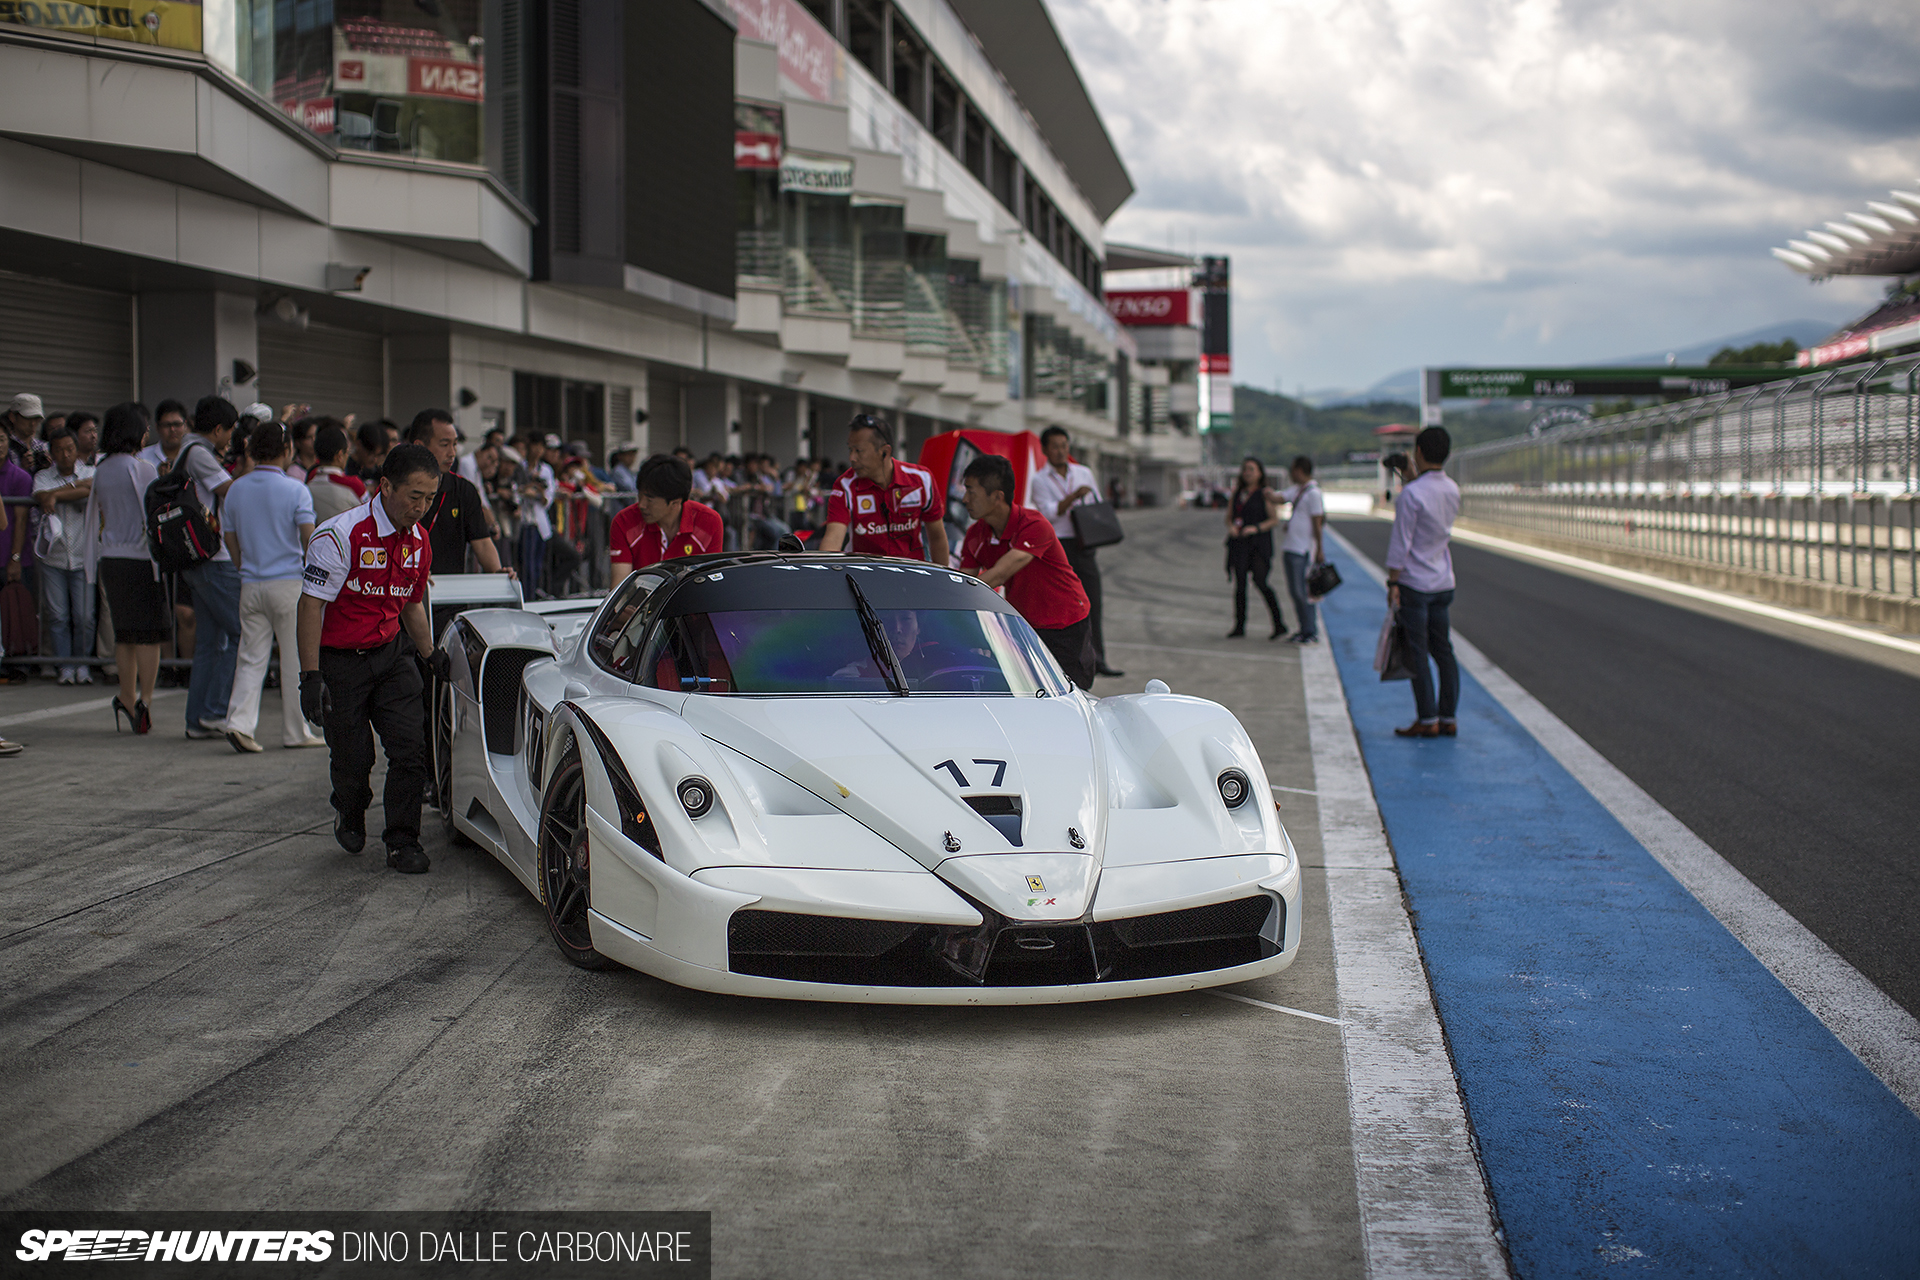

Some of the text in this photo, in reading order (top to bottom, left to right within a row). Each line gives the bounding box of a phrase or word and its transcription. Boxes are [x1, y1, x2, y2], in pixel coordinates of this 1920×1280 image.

[1104, 294, 1172, 318] ENSO
[362, 580, 414, 597] Santand
[528, 712, 542, 773] 17
[932, 757, 1008, 788] 17
